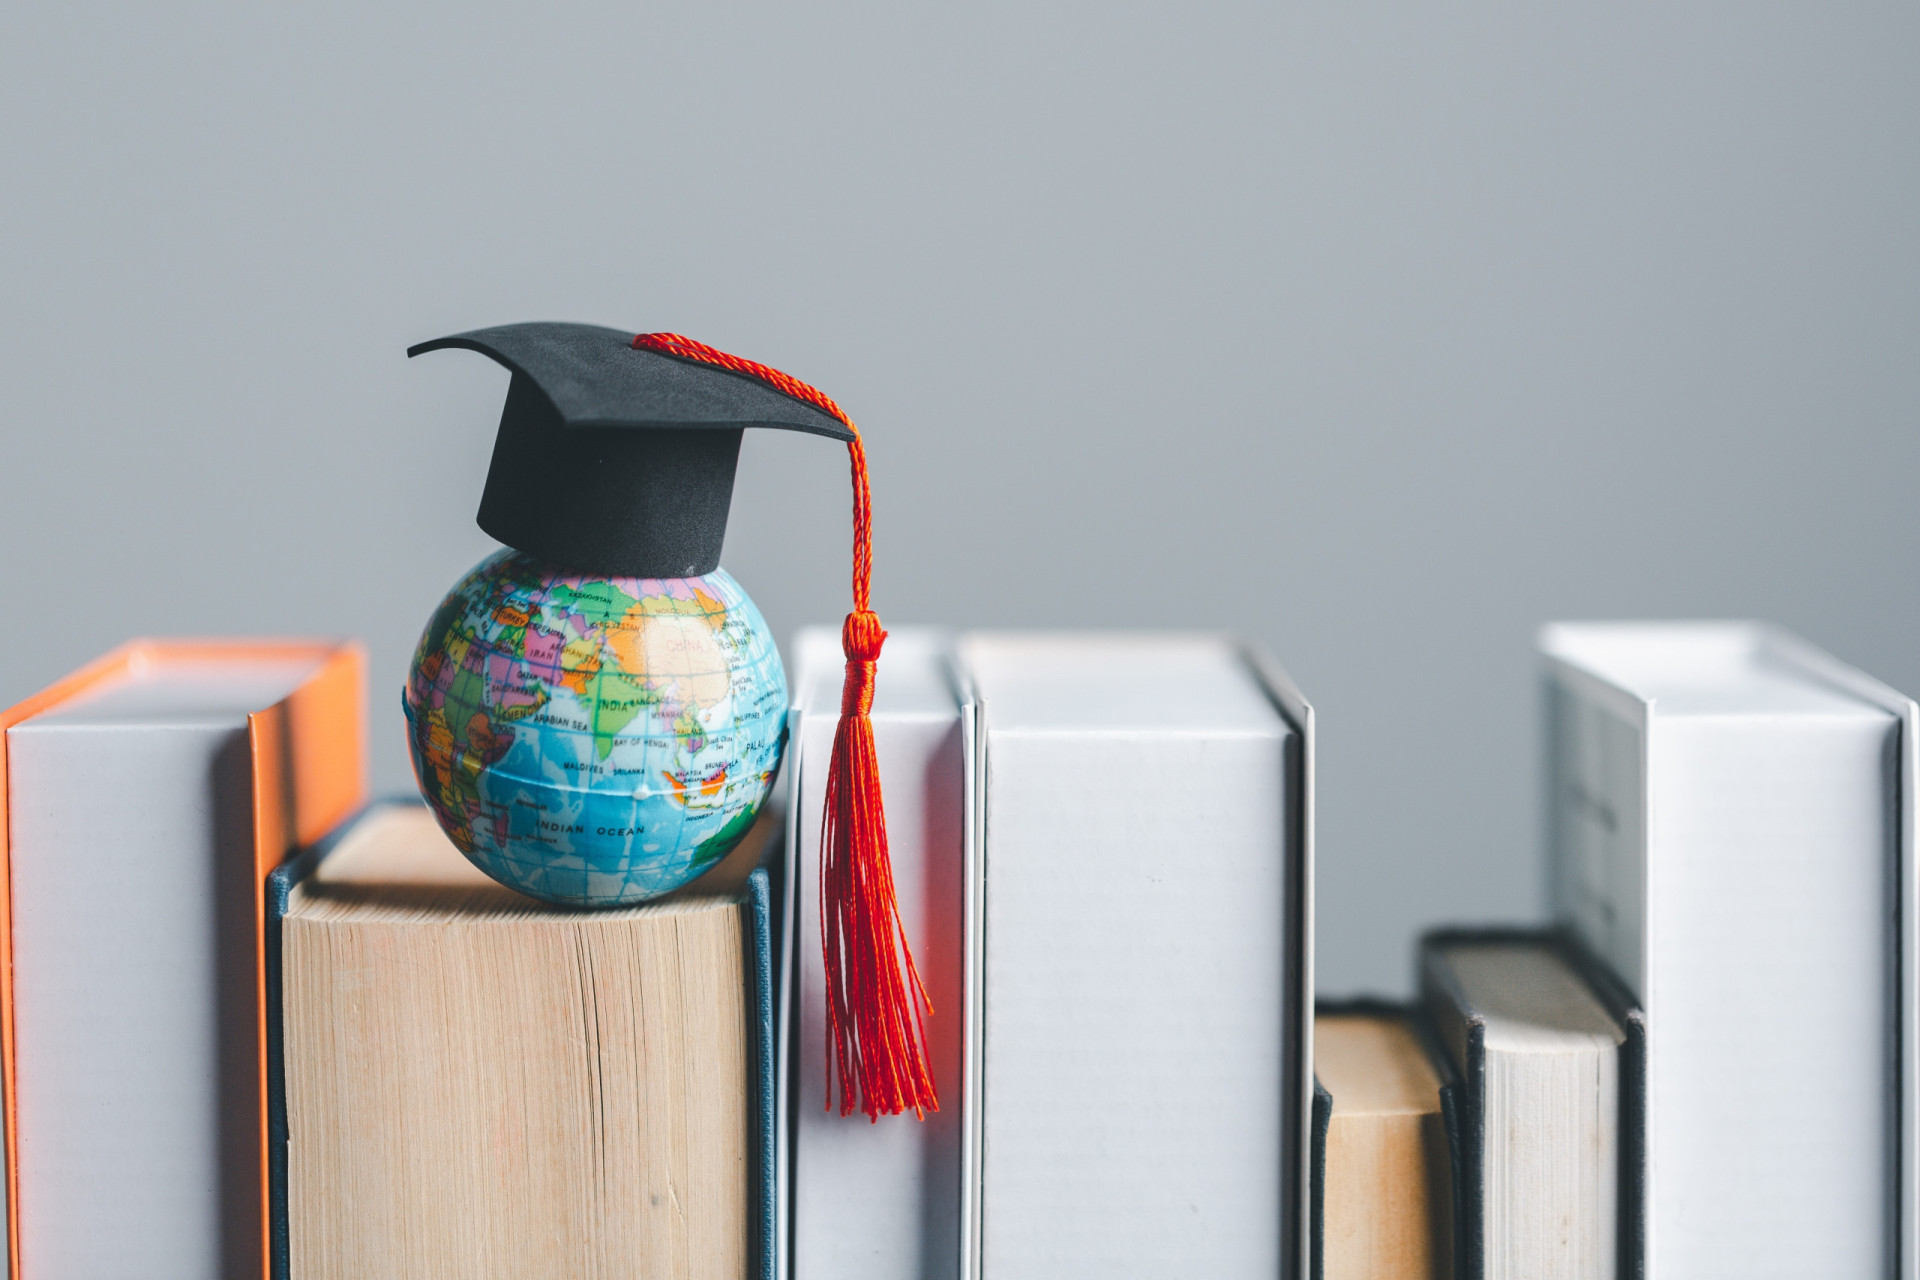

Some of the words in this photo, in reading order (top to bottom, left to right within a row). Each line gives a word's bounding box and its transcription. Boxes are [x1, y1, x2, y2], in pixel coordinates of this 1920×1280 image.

[568, 592, 613, 605] KAZAKHSTAN
[500, 610, 526, 626] TURKEY
[666, 639, 704, 652] CHINA
[530, 649, 553, 661] IRAN
[597, 699, 629, 713] INDIA
[533, 714, 569, 728] ARABIAN
[572, 720, 589, 732] SEA
[672, 728, 703, 736] THAILAND
[614, 739, 628, 747] BAY
[631, 738, 641, 746] OF
[563, 761, 605, 775] MALDIVES
[674, 769, 702, 778] MALAYSIA
[535, 818, 585, 834] INDIAN
[596, 825, 646, 837] OCEAN
